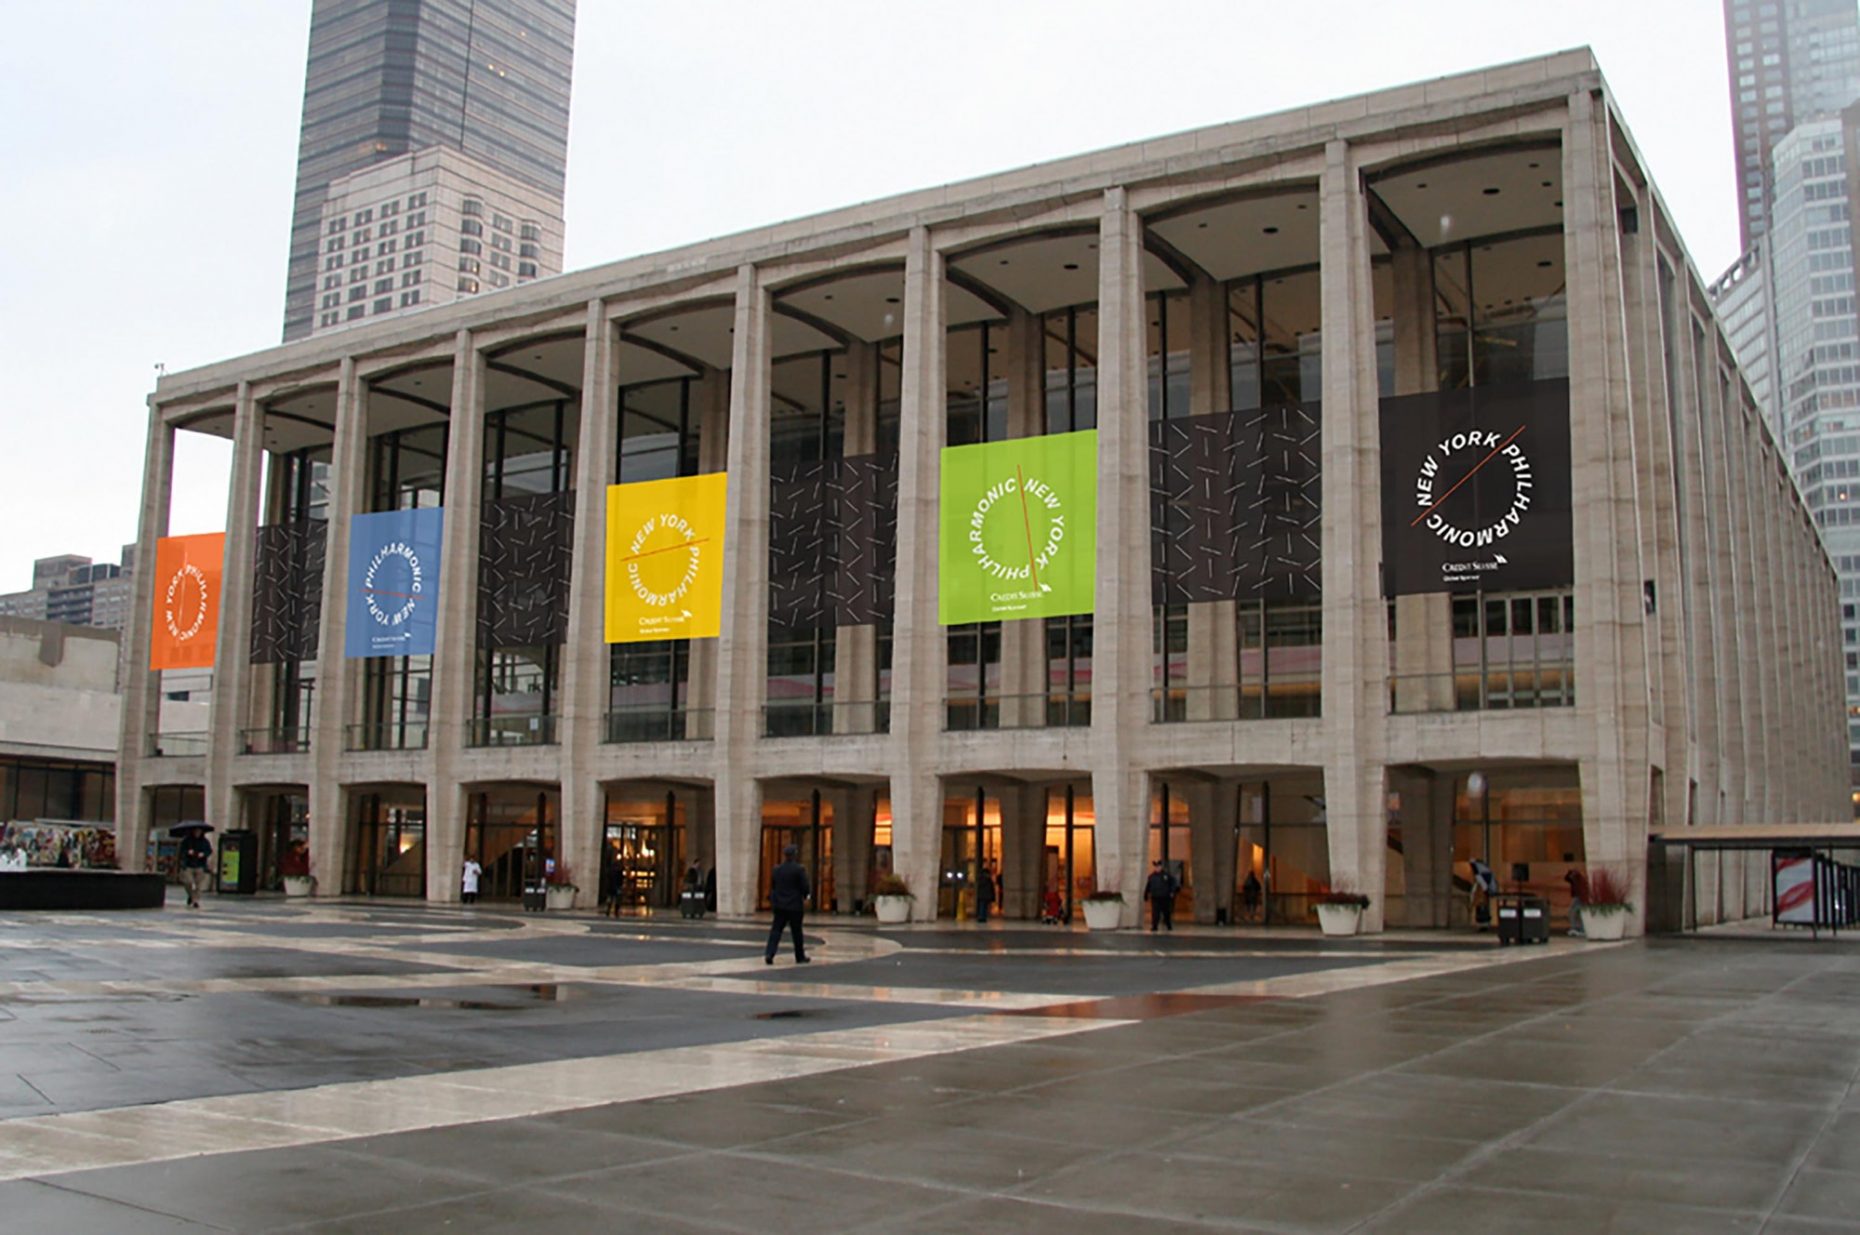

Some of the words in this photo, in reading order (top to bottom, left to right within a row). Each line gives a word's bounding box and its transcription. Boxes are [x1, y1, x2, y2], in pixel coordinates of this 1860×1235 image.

[1438, 430, 1502, 456] YORK
[1024, 478, 1061, 509] NEW
[1416, 454, 1439, 506] NEW
[1426, 443, 1533, 547] PHILHARMONIC
[630, 517, 655, 555] NEW
[660, 513, 696, 542] YORK
[969, 478, 1030, 580] PHILHARMONIC
[1035, 515, 1065, 570] YORK
[365, 542, 422, 593] PHILHARMONIC
[628, 545, 700, 606] PHILHARMONIC
[365, 594, 389, 626] YORK
[392, 598, 415, 626] NEW
